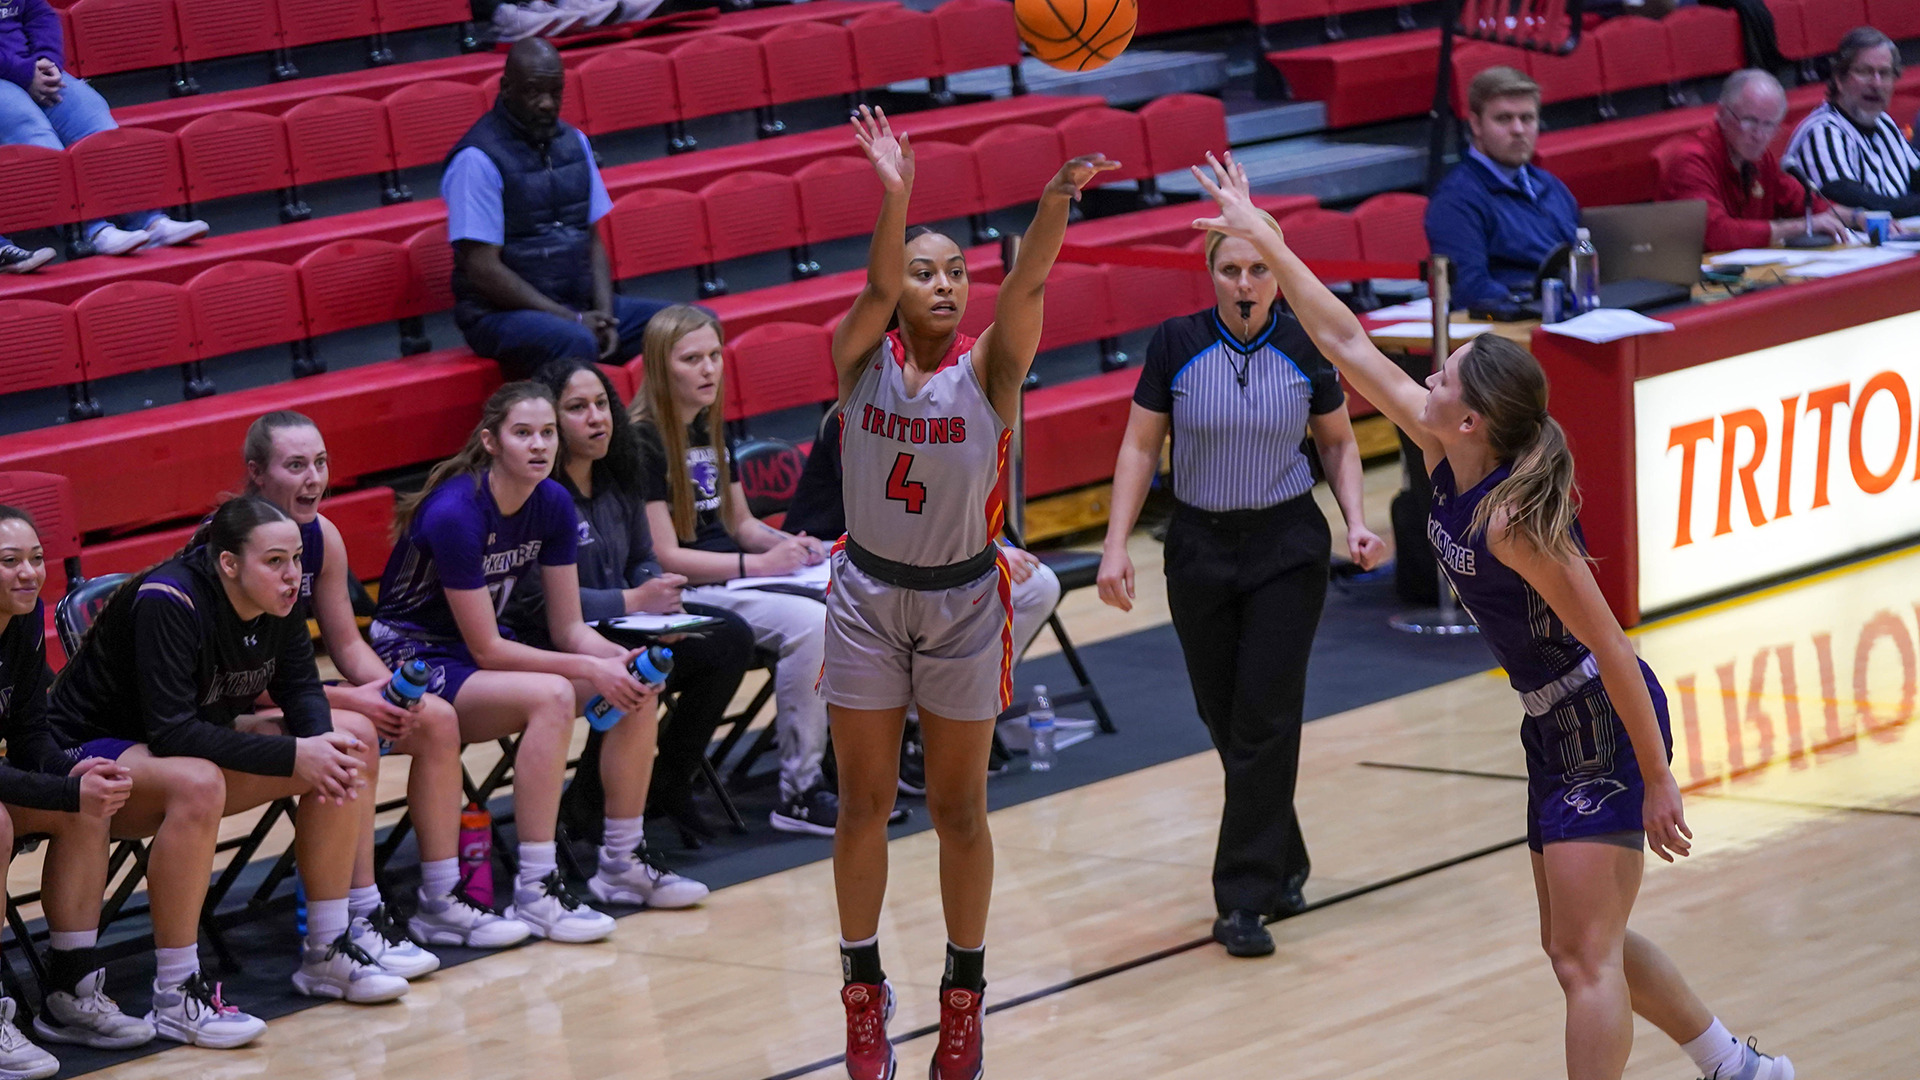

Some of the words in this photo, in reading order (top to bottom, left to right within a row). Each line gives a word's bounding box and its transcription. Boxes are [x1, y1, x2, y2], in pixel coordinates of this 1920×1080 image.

[861, 403, 966, 444] TRITONS
[886, 452, 926, 514] 4
[1666, 370, 1920, 549] TRITO
